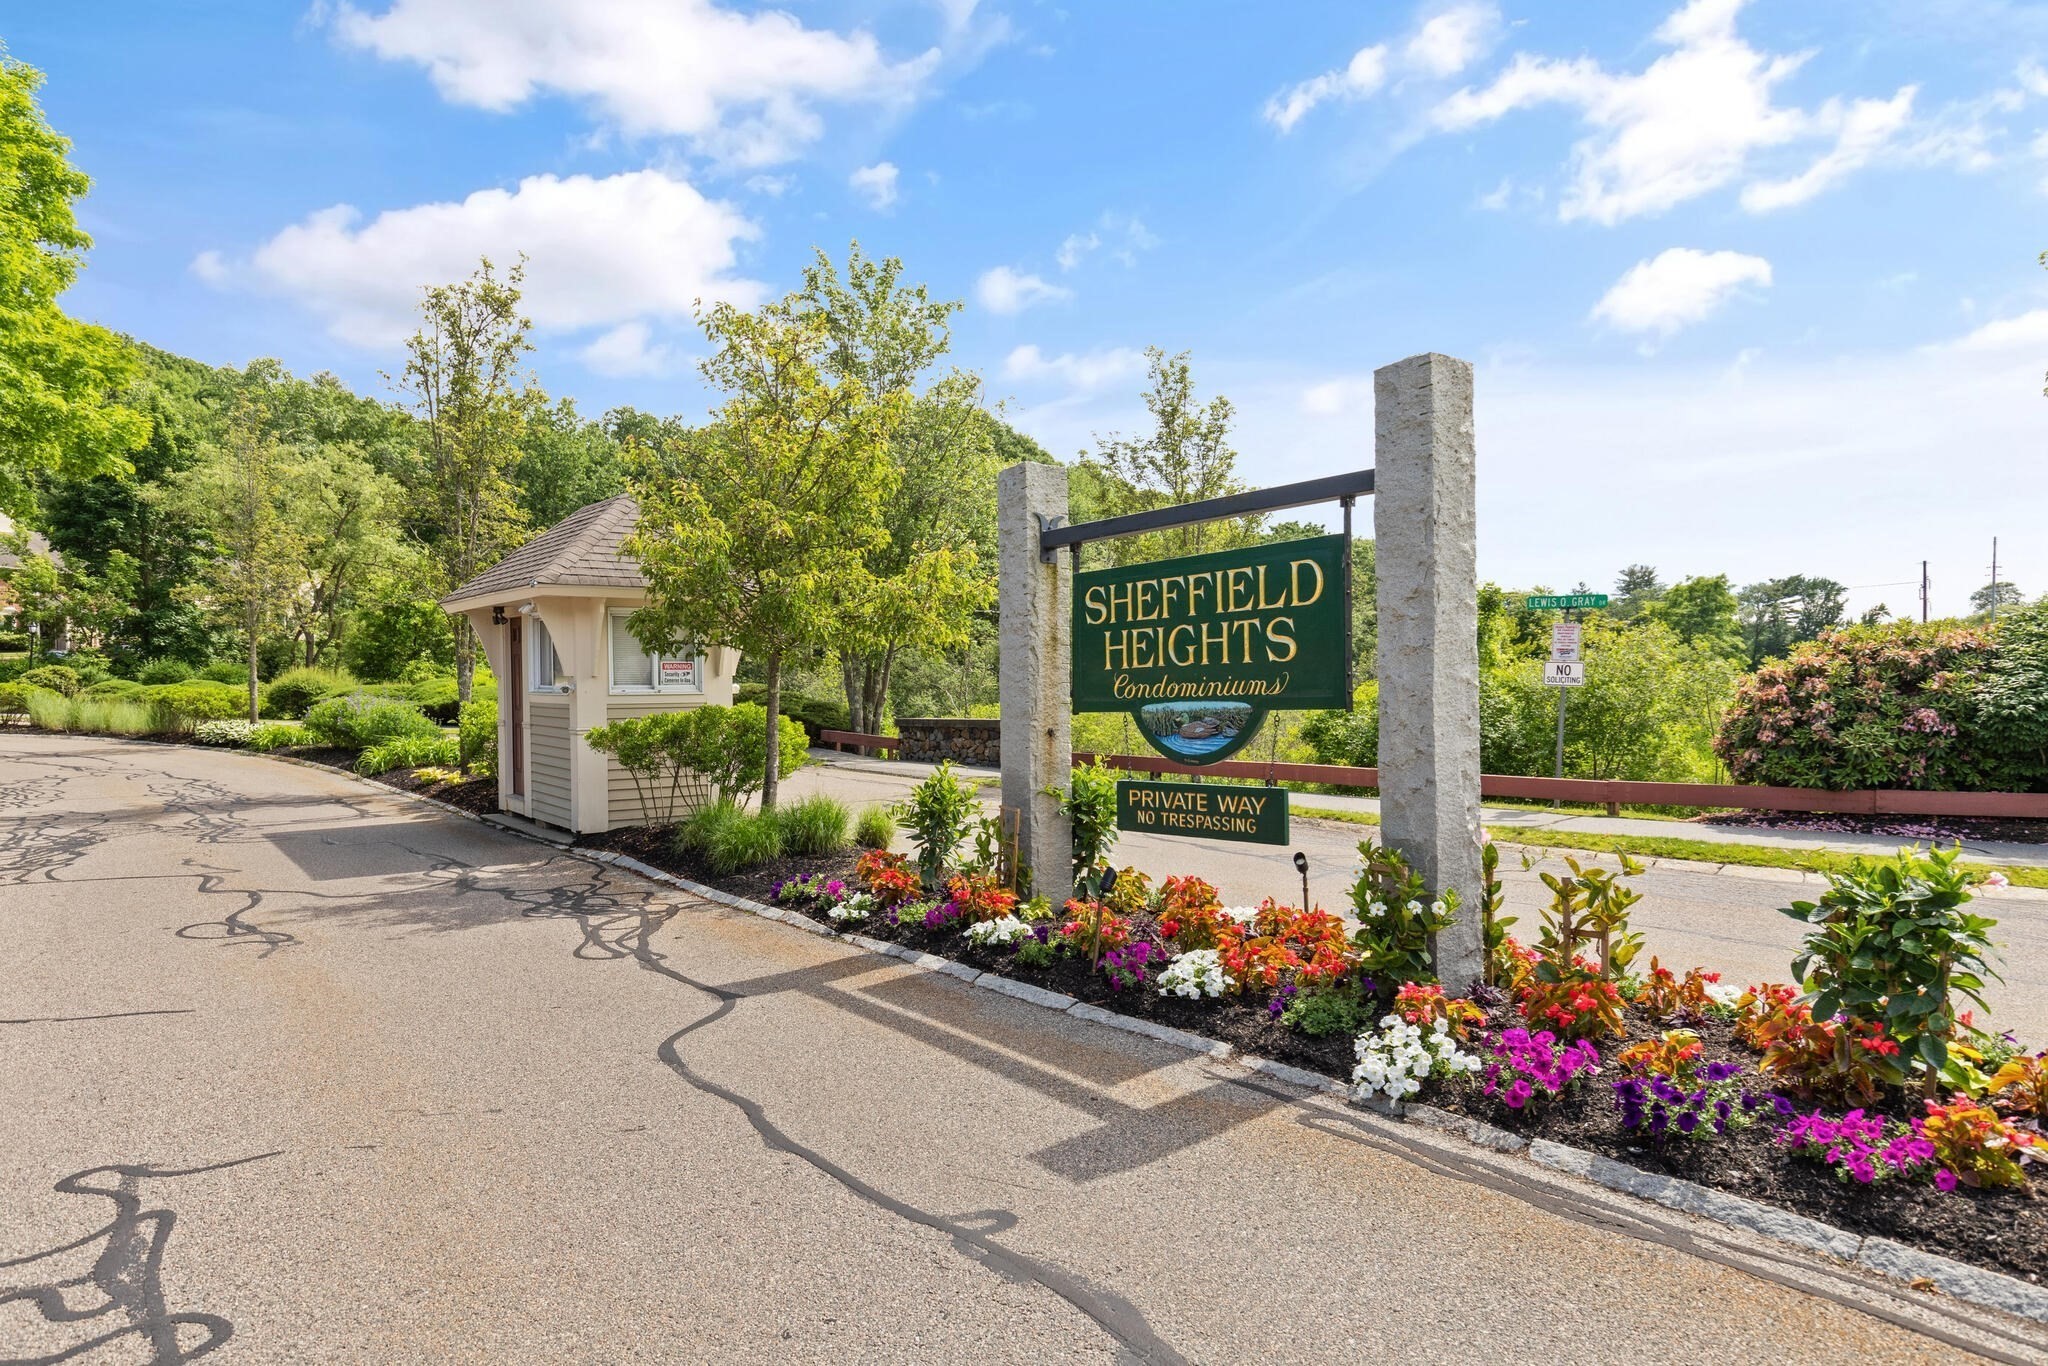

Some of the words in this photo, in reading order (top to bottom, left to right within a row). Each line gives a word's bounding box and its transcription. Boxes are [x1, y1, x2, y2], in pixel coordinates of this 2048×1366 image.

[1085, 559, 1324, 624] SHEFFIELD
[1529, 597, 1556, 608] LEWIS
[1560, 597, 1569, 607] O.
[1572, 596, 1595, 606] GRAY
[1104, 616, 1297, 670] HEIGHTS
[1546, 676, 1580, 684] SOLICITING
[1556, 665, 1571, 676] NO
[1113, 671, 1289, 699] Condominiums
[1129, 789, 1207, 812] PRIVATE
[1217, 794, 1266, 816] WAY
[1137, 810, 1155, 825] NO
[1161, 812, 1257, 834] TRESPASSING
